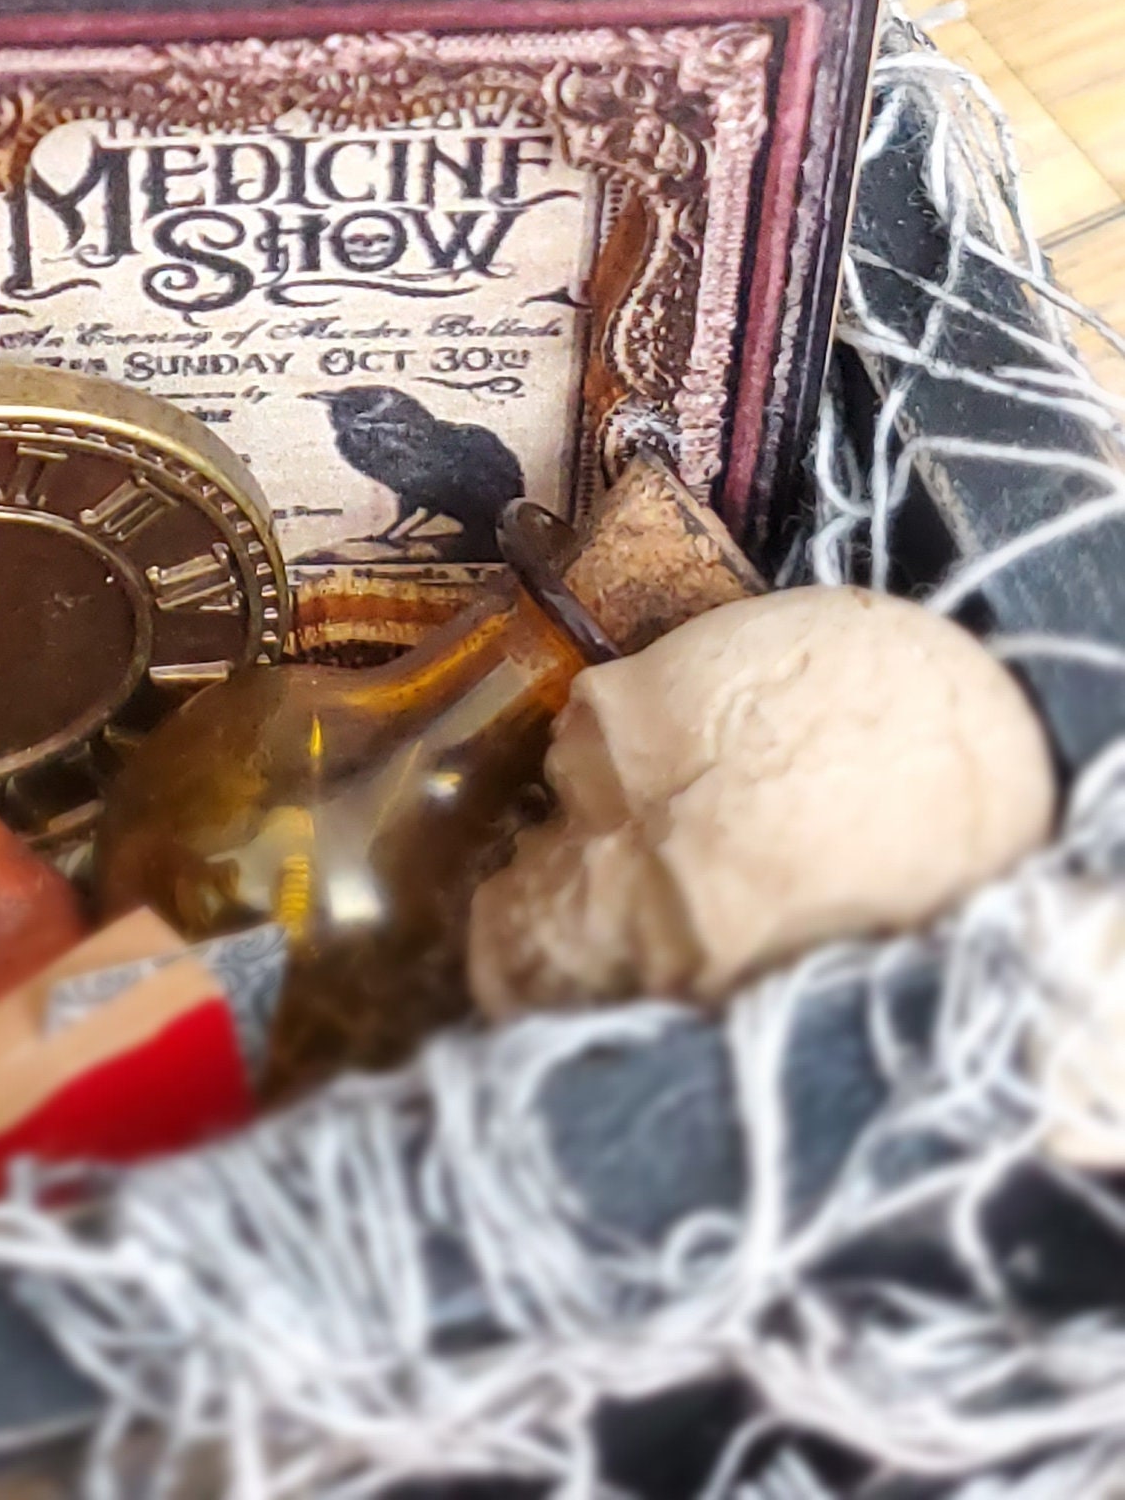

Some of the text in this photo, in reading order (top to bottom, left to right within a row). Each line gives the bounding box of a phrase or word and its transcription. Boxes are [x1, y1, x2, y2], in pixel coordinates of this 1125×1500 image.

[3, 134, 559, 298] MEDICINE
[141, 206, 515, 311] SHOW
[124, 350, 295, 382] SUNDAY
[318, 347, 418, 376] OCT
